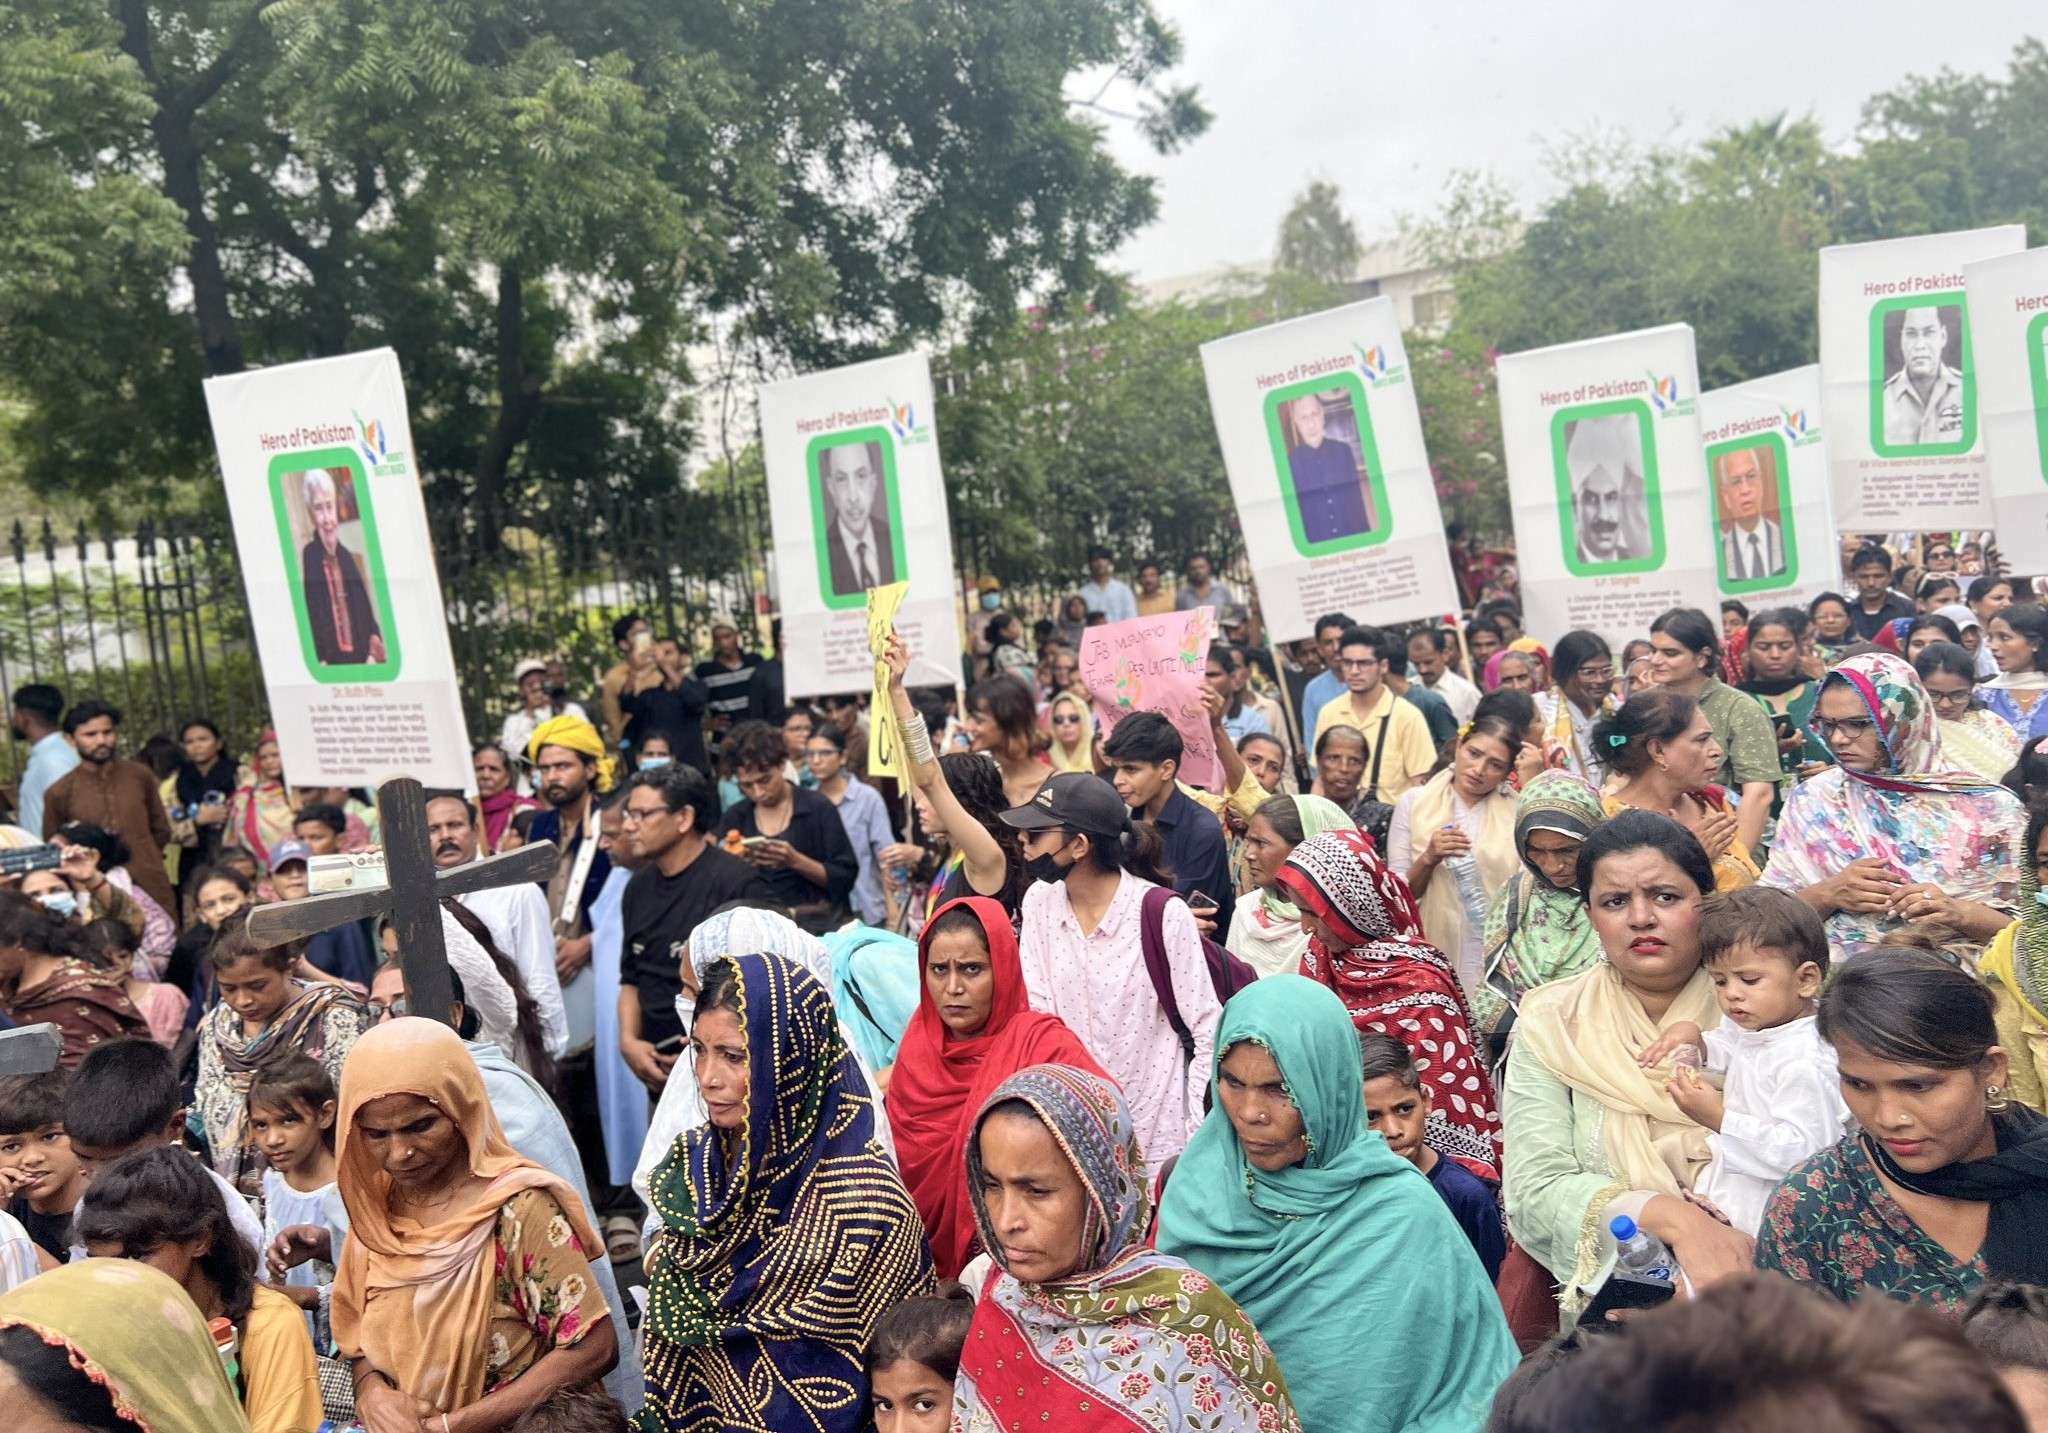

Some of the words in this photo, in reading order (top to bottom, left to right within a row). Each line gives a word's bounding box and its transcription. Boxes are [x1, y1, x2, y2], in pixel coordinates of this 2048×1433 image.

[1864, 280, 1896, 296] Hero
[1899, 279, 1912, 292] of
[1916, 273, 1965, 290] Pakista
[1256, 372, 1286, 389] Hero
[1287, 366, 1299, 381] of
[1301, 354, 1355, 376] Pakistan
[1540, 391, 1571, 406] Hero
[1573, 386, 1586, 400] of
[1589, 379, 1647, 399] Pakistan
[796, 417, 823, 433] Hero
[825, 412, 838, 428] of
[839, 406, 889, 423] Pakistan
[1719, 424, 1730, 438] of
[1732, 415, 1781, 436] Pakistan
[260, 432, 288, 451] Hero
[290, 427, 301, 447] of
[302, 424, 355, 446] Pakistan
